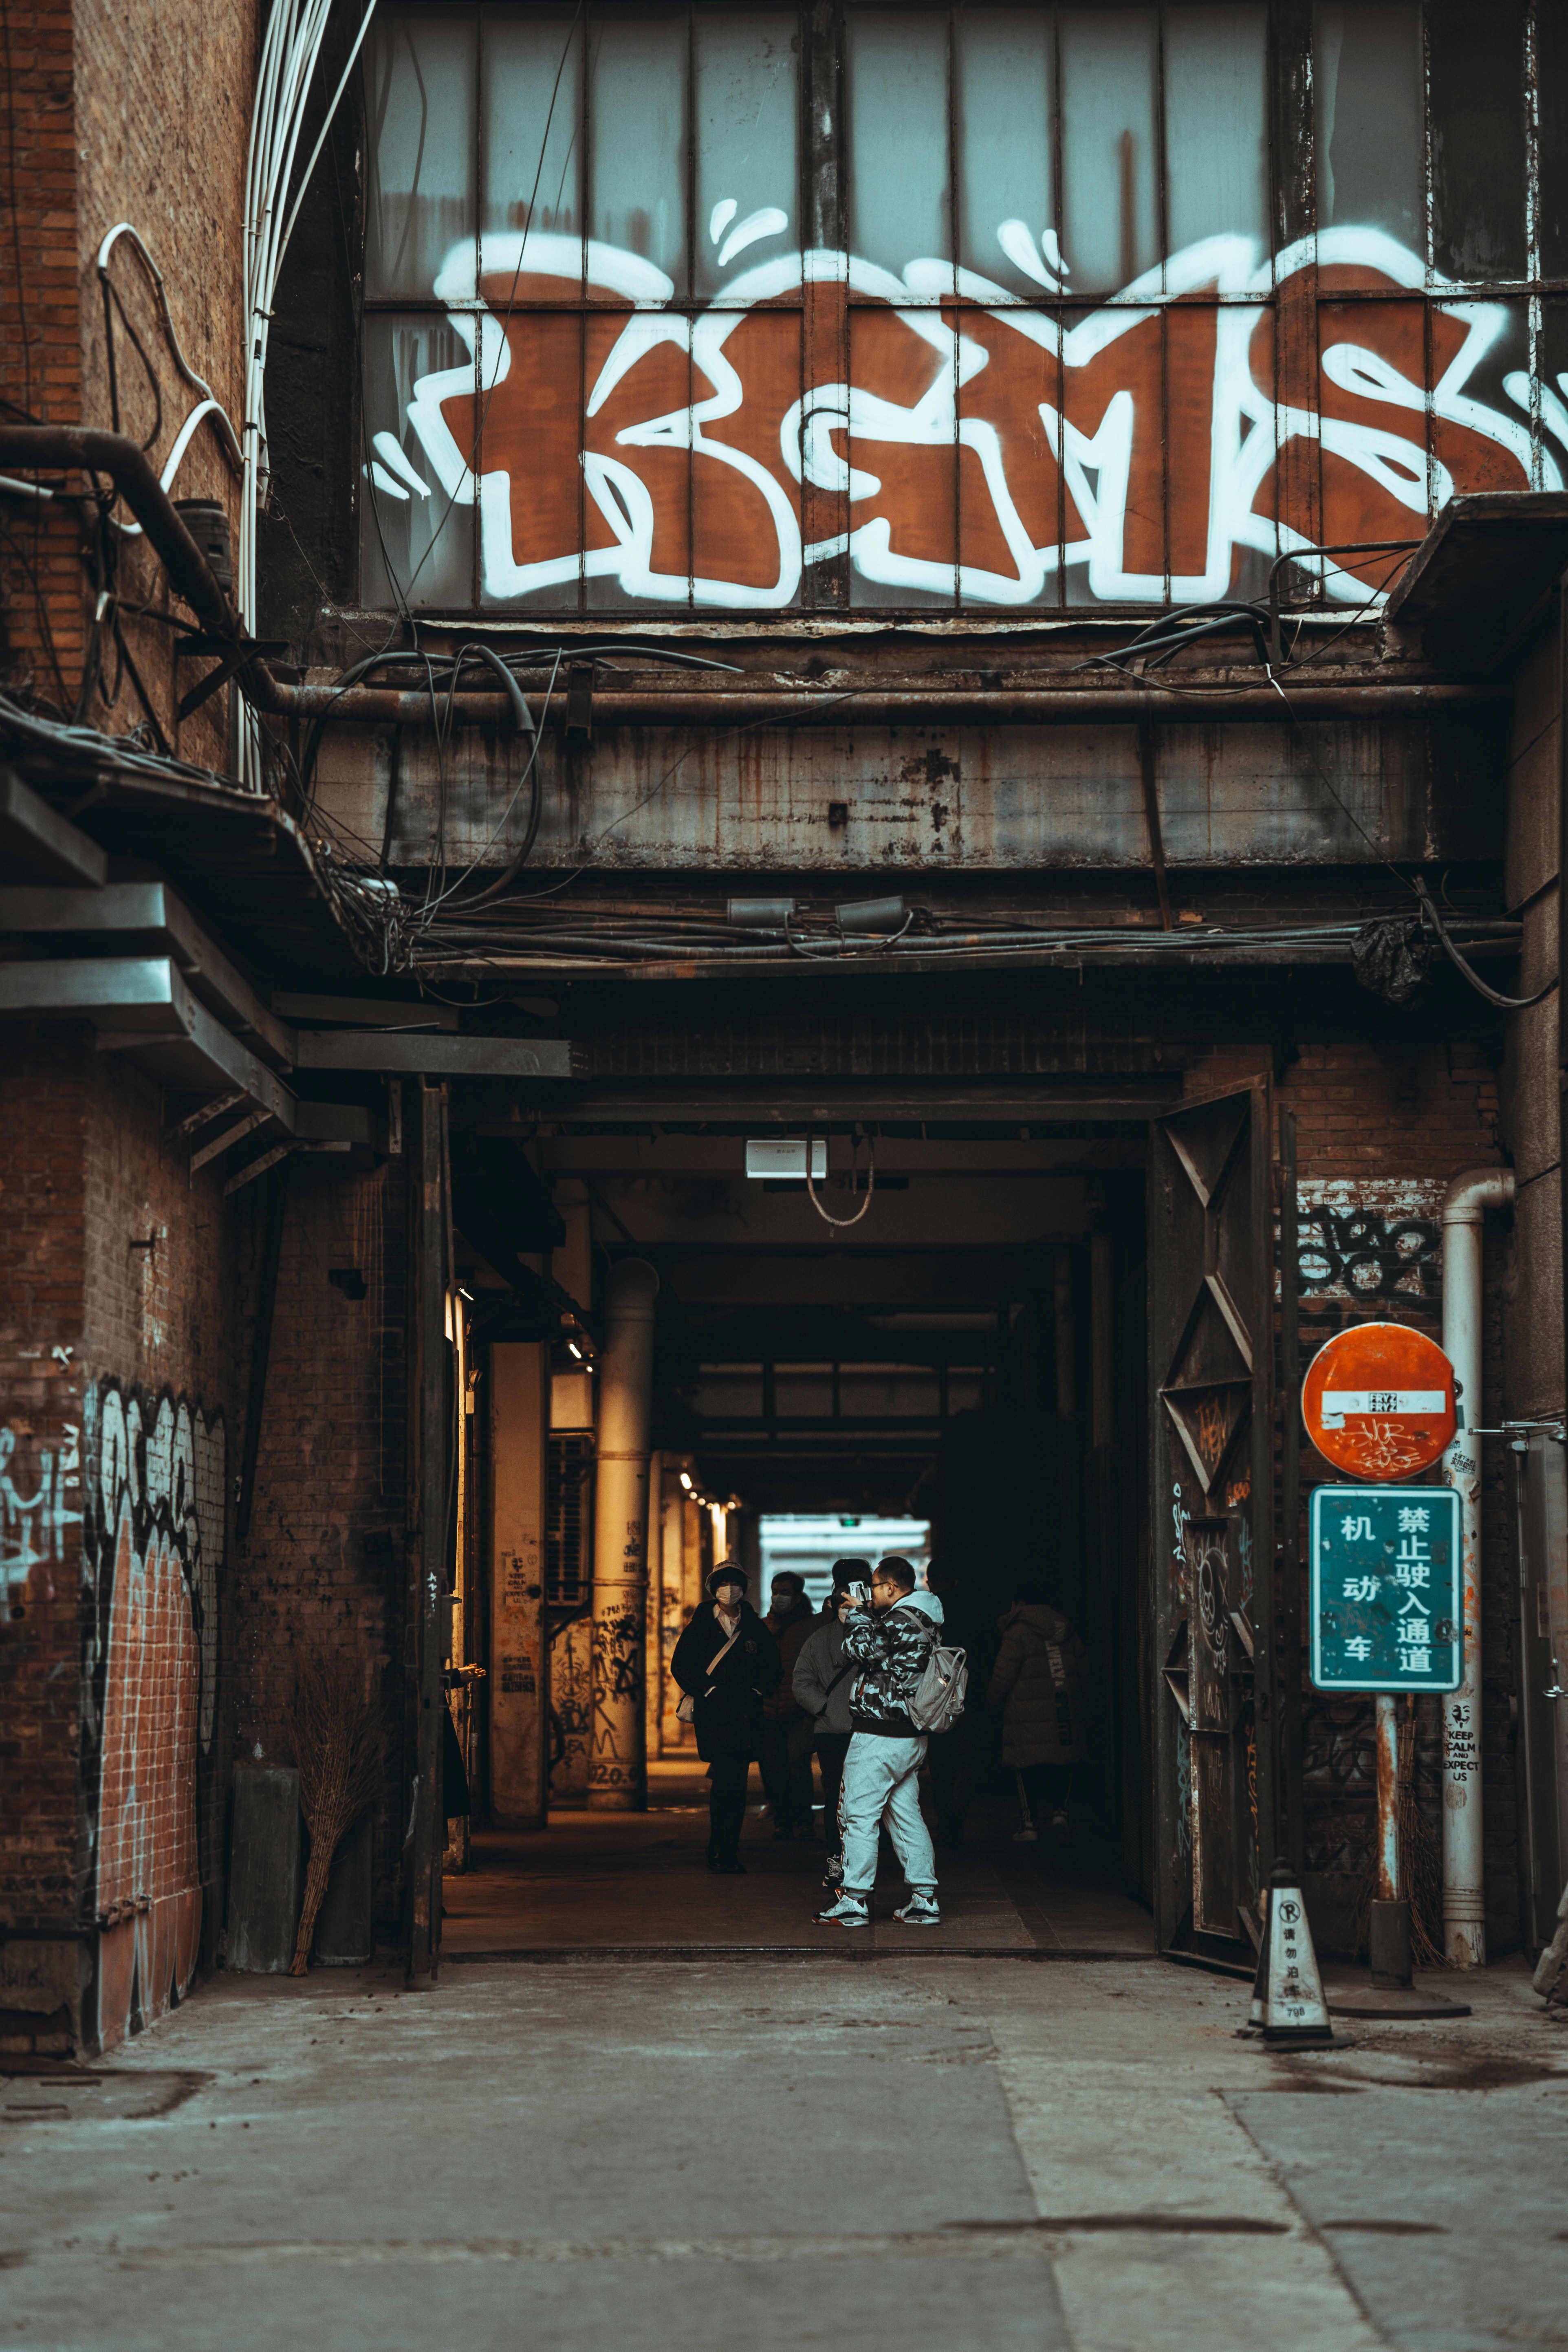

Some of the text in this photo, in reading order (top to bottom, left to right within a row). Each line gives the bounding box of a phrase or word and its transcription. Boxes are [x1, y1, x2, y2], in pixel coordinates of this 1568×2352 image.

[1370, 1393, 1397, 1403] FRYZ
[1370, 1403, 1397, 1412] FRYZ
[1341, 1515, 1376, 1661] 机动车
[1396, 1506, 1432, 1673] 禁止驶入通道
[1449, 1731, 1473, 1740] KEEP
[1447, 1742, 1476, 1752] CALM
[1444, 1760, 1479, 1771] EXPECT
[1453, 1772, 1467, 1781] US
[1284, 1928, 1299, 1995] 请勿泊车
[1287, 2006, 1306, 2017] 798
